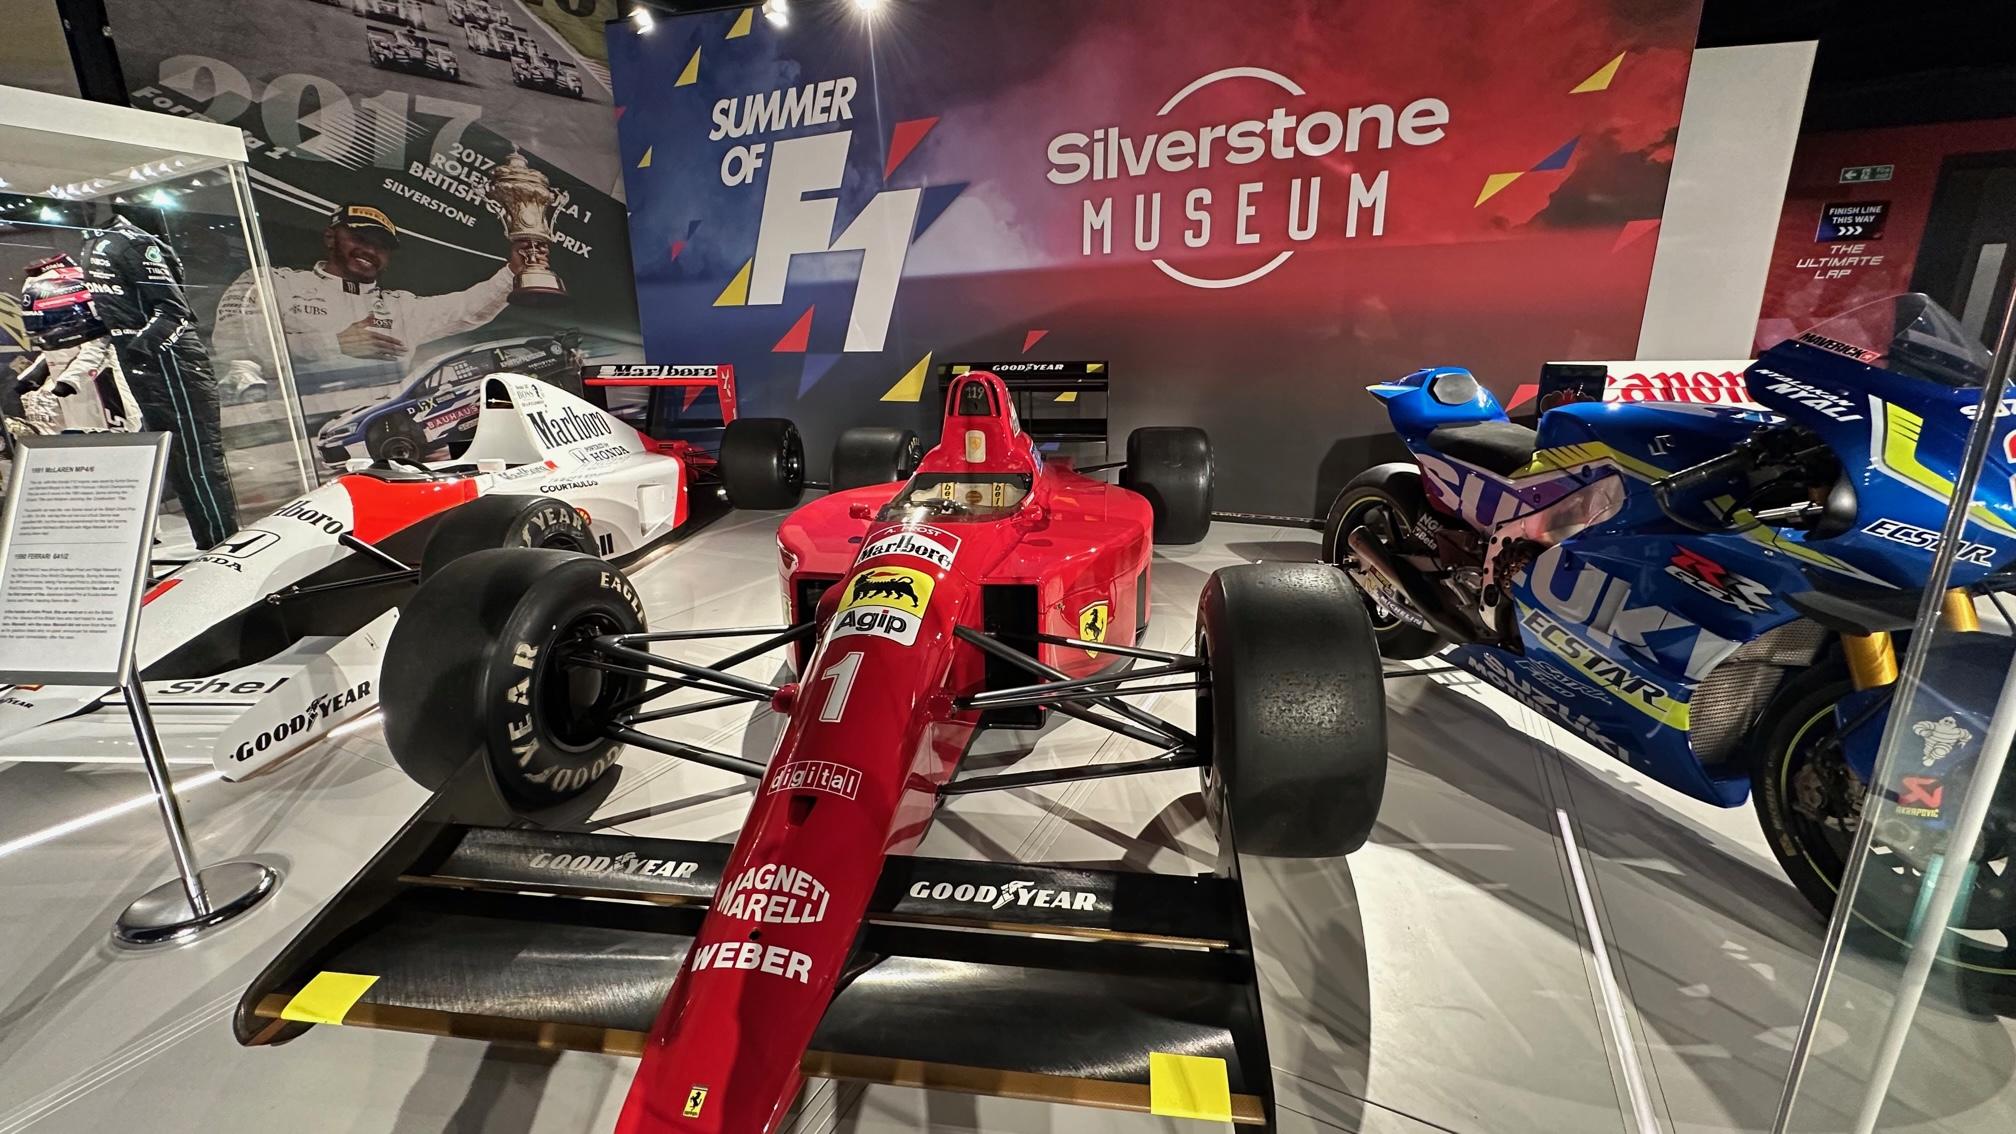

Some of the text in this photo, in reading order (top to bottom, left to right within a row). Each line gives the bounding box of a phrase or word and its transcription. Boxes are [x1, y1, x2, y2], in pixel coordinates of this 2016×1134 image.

[159, 55, 482, 170] 2017
[709, 76, 857, 141] SUMMER
[451, 142, 495, 171] 2017
[1046, 97, 1450, 185] Silverstone
[431, 152, 489, 192] ROLEX
[721, 144, 765, 188] OF
[382, 178, 478, 228] SILVERSTONE
[408, 161, 593, 258] BRITISH PRIX
[1082, 171, 1389, 255] MUSEUM
[1829, 205, 1883, 215] FINISH LINE
[1832, 215, 1876, 224] THIS WAY
[747, 130, 921, 352] F1
[1830, 244, 1866, 254] THE
[1796, 256, 1884, 268] ULTIMATE
[1814, 269, 1852, 280] LAP
[304, 305, 328, 316] UBS
[1799, 332, 1865, 360] MAVERICK
[613, 365, 717, 378] Marlboro
[966, 386, 985, 399] 119
[1766, 384, 1863, 422] NYALI
[427, 405, 479, 428] BAUHAUS
[527, 407, 612, 450] Marlboro
[590, 445, 630, 461] HONDA
[540, 480, 598, 494] COURTAULDS
[273, 501, 343, 534] lboro
[196, 557, 242, 573] NDA
[858, 534, 952, 567] Marlboro
[600, 571, 645, 625] EAGLE
[834, 609, 907, 634] Agip
[1524, 610, 1669, 713] ECSTAR
[158, 677, 291, 695] Shel
[817, 652, 864, 723] 1
[1484, 652, 1630, 763] SUZUKI
[769, 764, 859, 797] digital
[691, 942, 813, 984] WEBER
